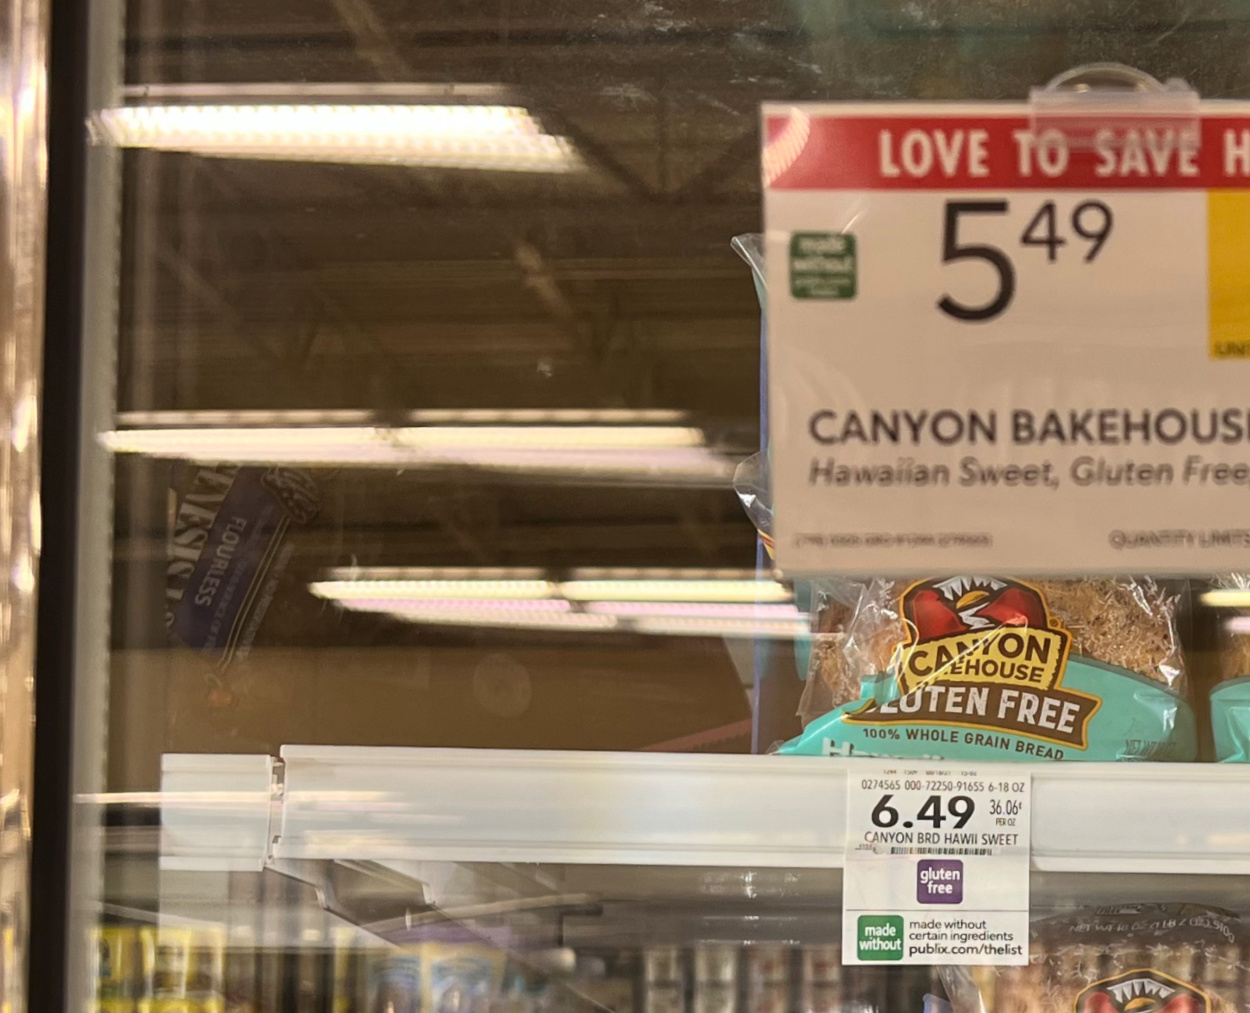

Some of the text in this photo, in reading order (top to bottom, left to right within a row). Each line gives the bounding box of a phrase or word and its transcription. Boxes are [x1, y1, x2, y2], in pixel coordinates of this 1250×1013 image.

[879, 128, 990, 177] LOVE
[1013, 129, 1070, 177] TO
[1095, 129, 1199, 178] SAVE
[808, 408, 998, 447] CANYON
[958, 455, 1060, 491] Sweet,
[1070, 455, 1174, 488] Gluten
[194, 514, 247, 608] FLOURLESS
[908, 632, 1051, 677] CANYON
[861, 780, 901, 791] 0274565
[1012, 782, 1025, 792] OZ
[871, 794, 975, 829] 6.49
[864, 831, 913, 844] CANYON
[917, 832, 940, 845] BRD
[981, 833, 1019, 845] SWEET
[920, 867, 960, 884] gluten
[927, 881, 953, 895] free
[909, 919, 987, 929] made without
[859, 937, 902, 951] without
[909, 931, 1014, 943] certain ingredients
[909, 943, 1023, 958] publix.com/thelist
